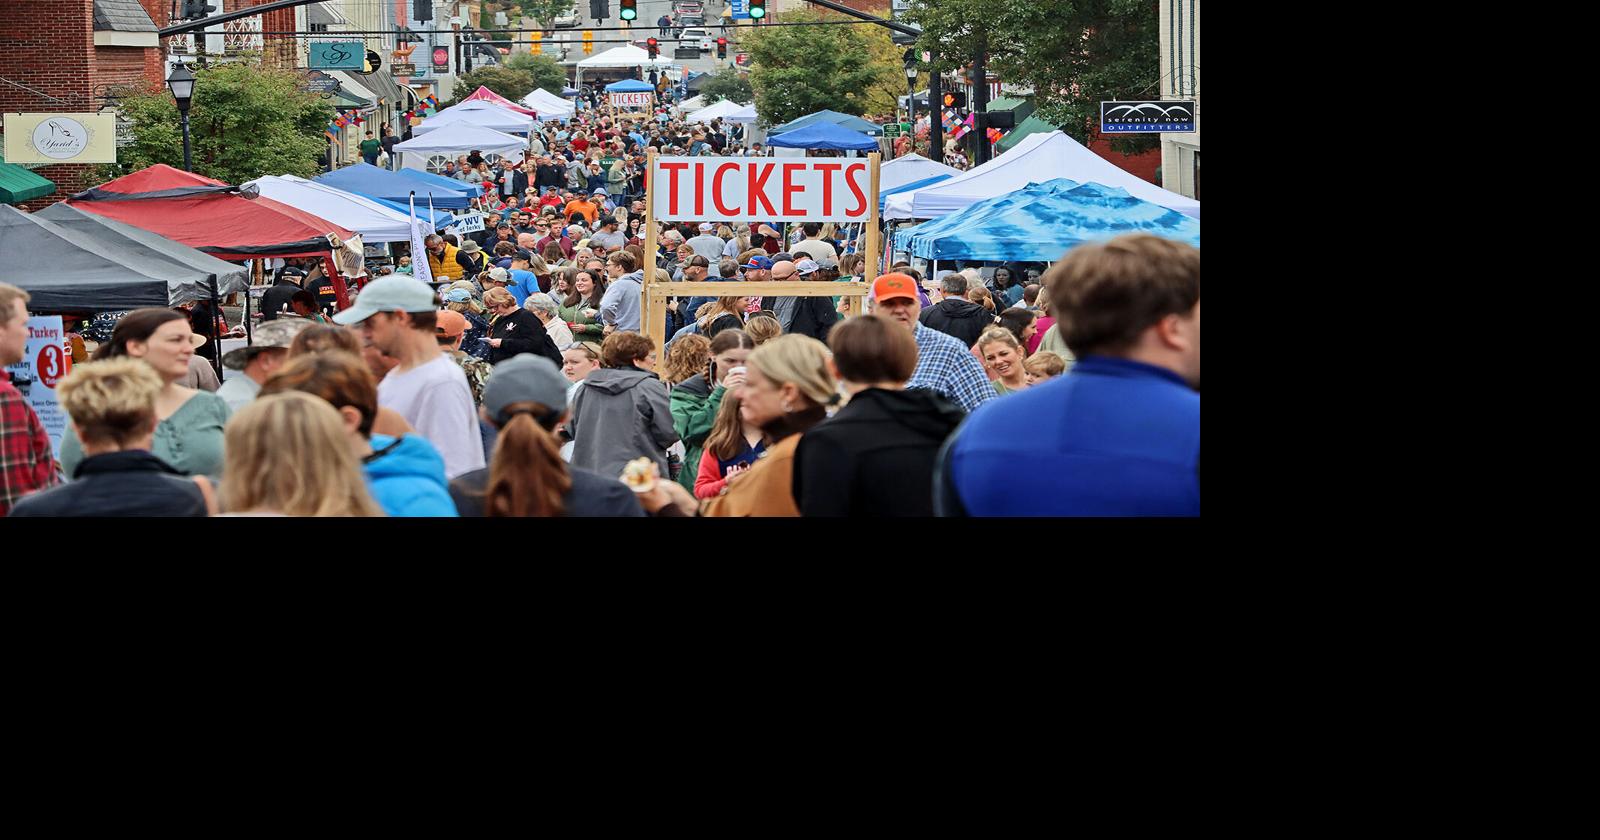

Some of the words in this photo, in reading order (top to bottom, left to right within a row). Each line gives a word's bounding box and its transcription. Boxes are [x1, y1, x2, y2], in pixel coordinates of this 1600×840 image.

[612, 93, 650, 104] TICKETS
[659, 162, 868, 217] TICKETS
[464, 215, 479, 225] WV
[28, 326, 59, 341] Turkey
[45, 347, 58, 377] 3
